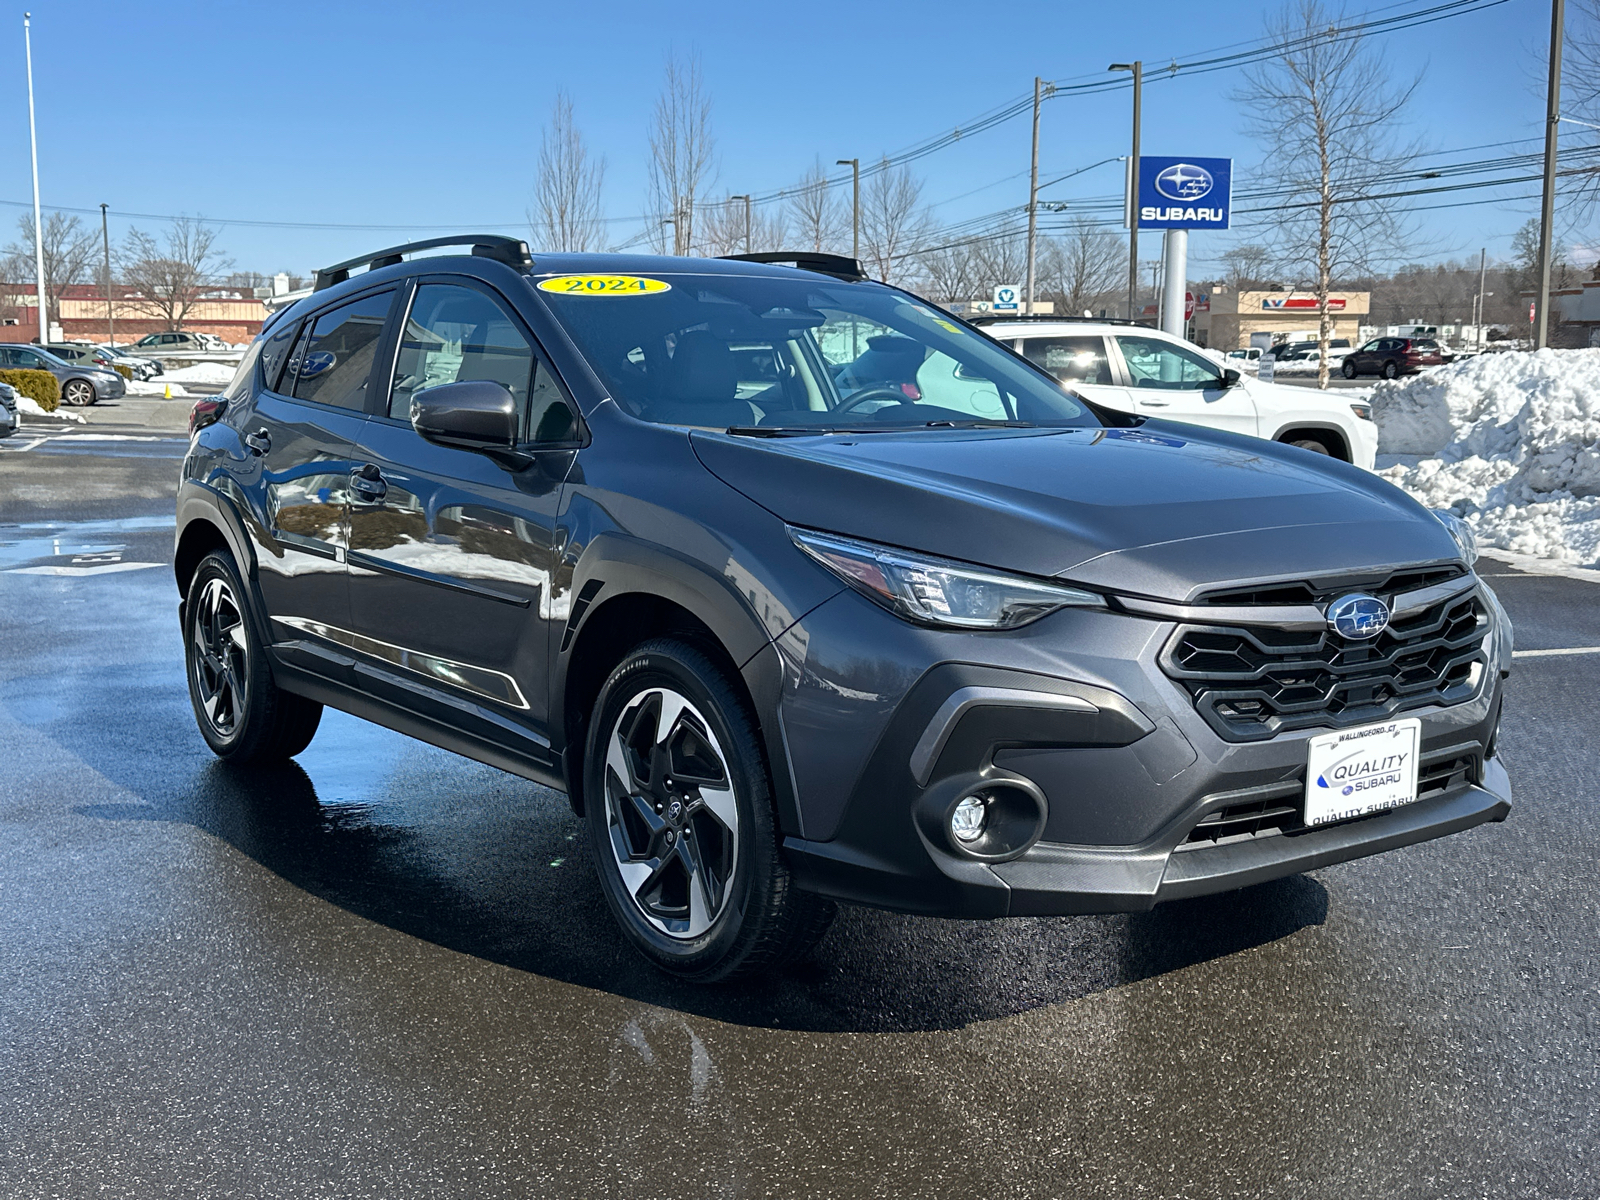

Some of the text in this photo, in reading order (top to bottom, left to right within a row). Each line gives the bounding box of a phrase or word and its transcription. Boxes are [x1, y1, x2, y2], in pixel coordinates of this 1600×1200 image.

[1141, 207, 1223, 221] SUBARU
[565, 279, 649, 292] 2024
[1334, 753, 1408, 780] QUALITY
[1355, 774, 1401, 792] SUBARU
[1312, 796, 1413, 826] QUALITY SUBARU
